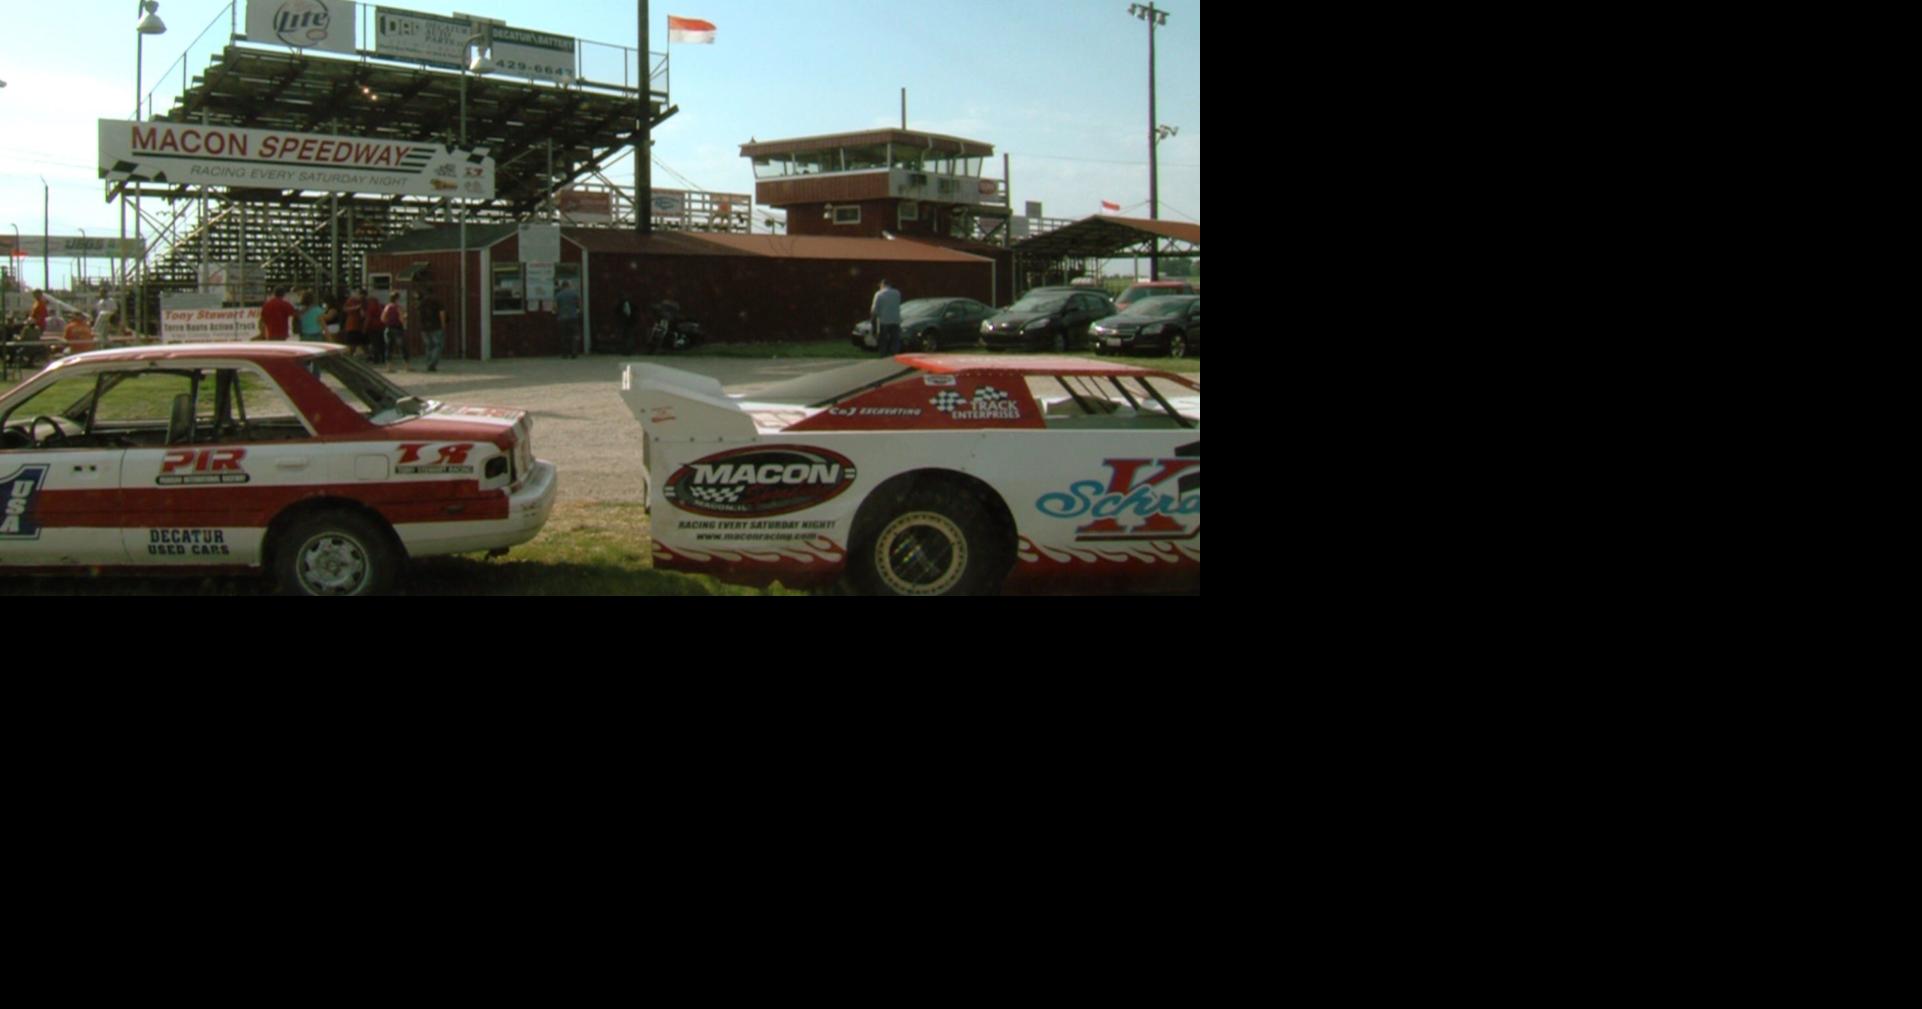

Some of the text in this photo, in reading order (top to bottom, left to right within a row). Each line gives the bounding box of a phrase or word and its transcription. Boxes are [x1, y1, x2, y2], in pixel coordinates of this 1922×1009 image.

[278, 10, 328, 32] Lite
[132, 125, 411, 167] MACON SPEEDWAY
[190, 165, 408, 187] RACING EVERY SATURDAY NIGHT
[165, 310, 193, 322] Tony
[196, 309, 245, 320] Stewart
[952, 410, 1021, 420] ENTERPRISES
[971, 400, 1018, 412] TRACK
[162, 447, 247, 473] PIR
[693, 463, 841, 485] MACON
[0, 480, 35, 533] USA
[678, 520, 716, 530] RACING
[718, 520, 748, 530] EVERY
[750, 520, 800, 529] SATURDAY
[149, 529, 225, 543] DECATUR
[147, 544, 230, 555] USED CARS
